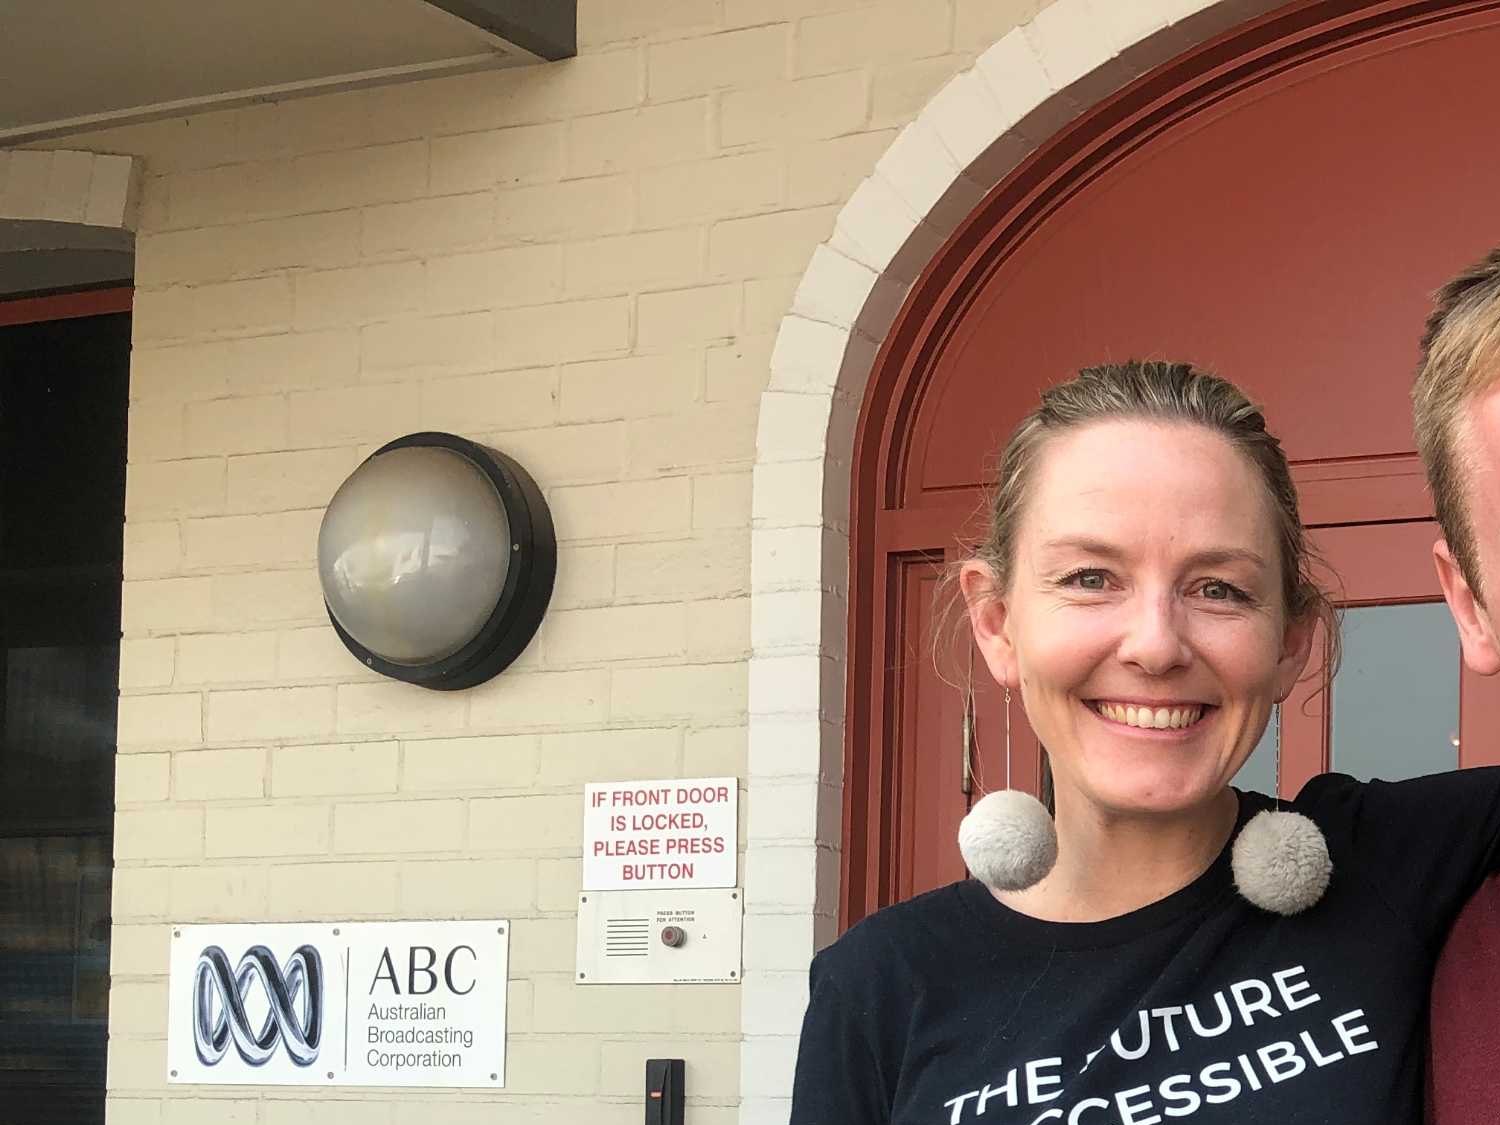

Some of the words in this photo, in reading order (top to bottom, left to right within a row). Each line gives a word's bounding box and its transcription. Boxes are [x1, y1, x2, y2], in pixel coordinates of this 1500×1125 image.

[592, 792, 607, 807] IF
[612, 789, 671, 807] FRONT
[676, 786, 729, 805] DOOR
[611, 815, 627, 832] IS
[632, 812, 708, 831] LOCKED,
[593, 839, 661, 857] PLEASE
[666, 836, 725, 855] PRESS
[622, 862, 695, 881] BUTTON
[368, 945, 478, 996] ABC
[367, 1003, 446, 1021] Australian
[1079, 965, 1321, 1075] UTURE
[367, 1026, 474, 1048] Broadcasting
[367, 1050, 462, 1071] Corporation
